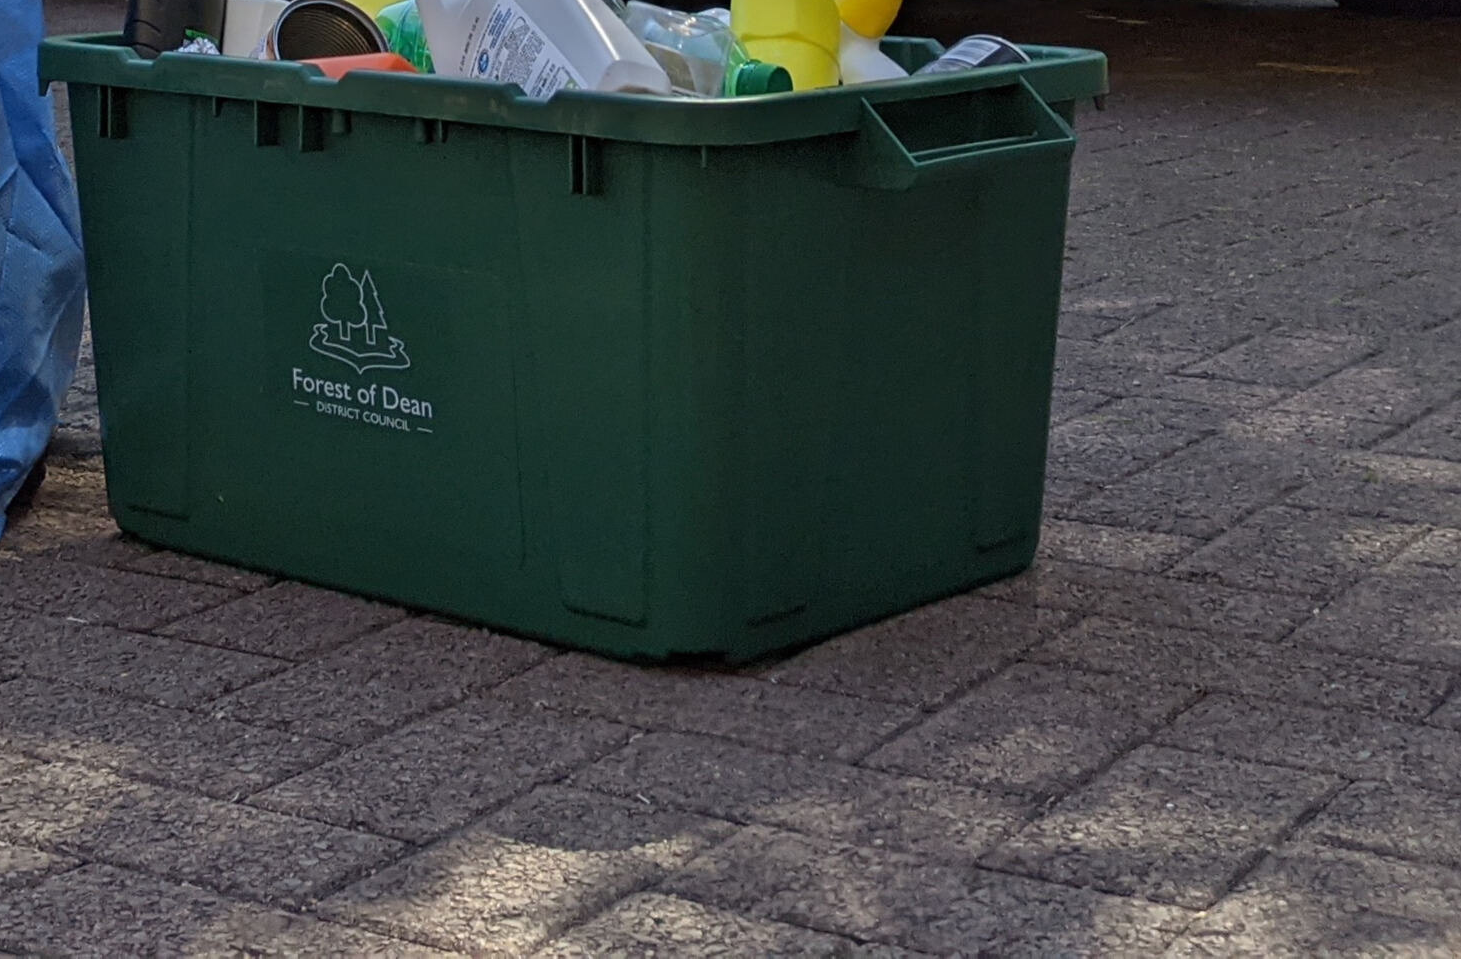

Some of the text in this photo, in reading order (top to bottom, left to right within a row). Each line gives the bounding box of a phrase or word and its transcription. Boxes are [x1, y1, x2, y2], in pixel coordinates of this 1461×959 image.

[292, 367, 433, 418] Forest of Dean
[316, 400, 411, 432] DISTRICT COUNCIL
